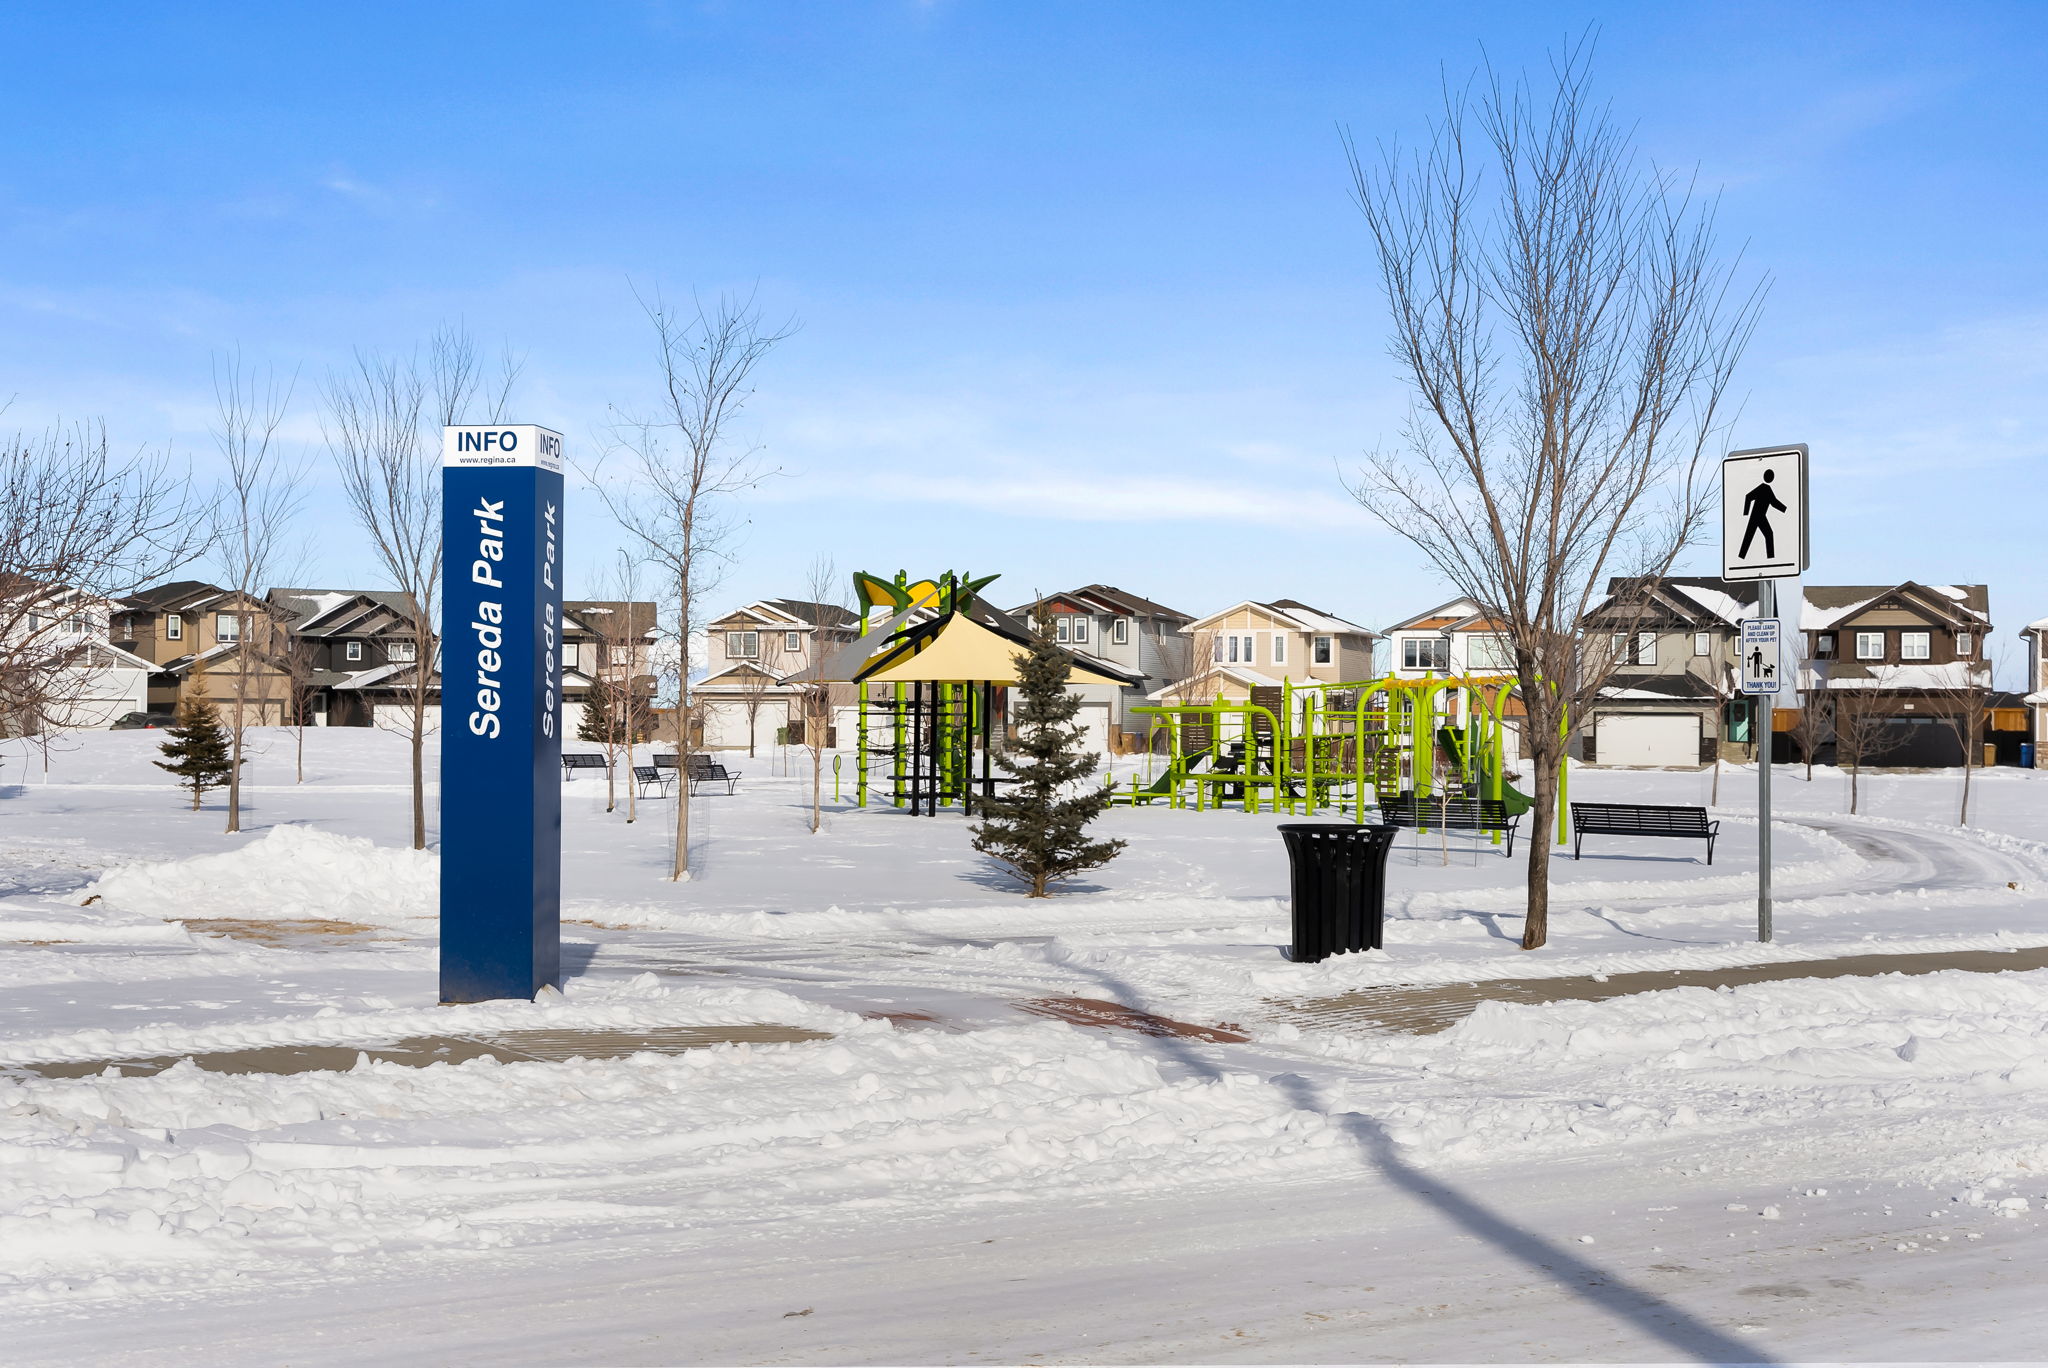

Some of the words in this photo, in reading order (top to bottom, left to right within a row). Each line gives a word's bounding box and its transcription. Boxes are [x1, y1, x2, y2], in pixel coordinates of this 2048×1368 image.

[458, 431, 517, 451] INFO
[460, 456, 515, 465] www.regina.ca
[540, 434, 560, 458] INFO
[472, 496, 505, 588] Park
[543, 500, 557, 590] Park
[469, 600, 502, 739] Sereda
[543, 602, 555, 739] Sereda
